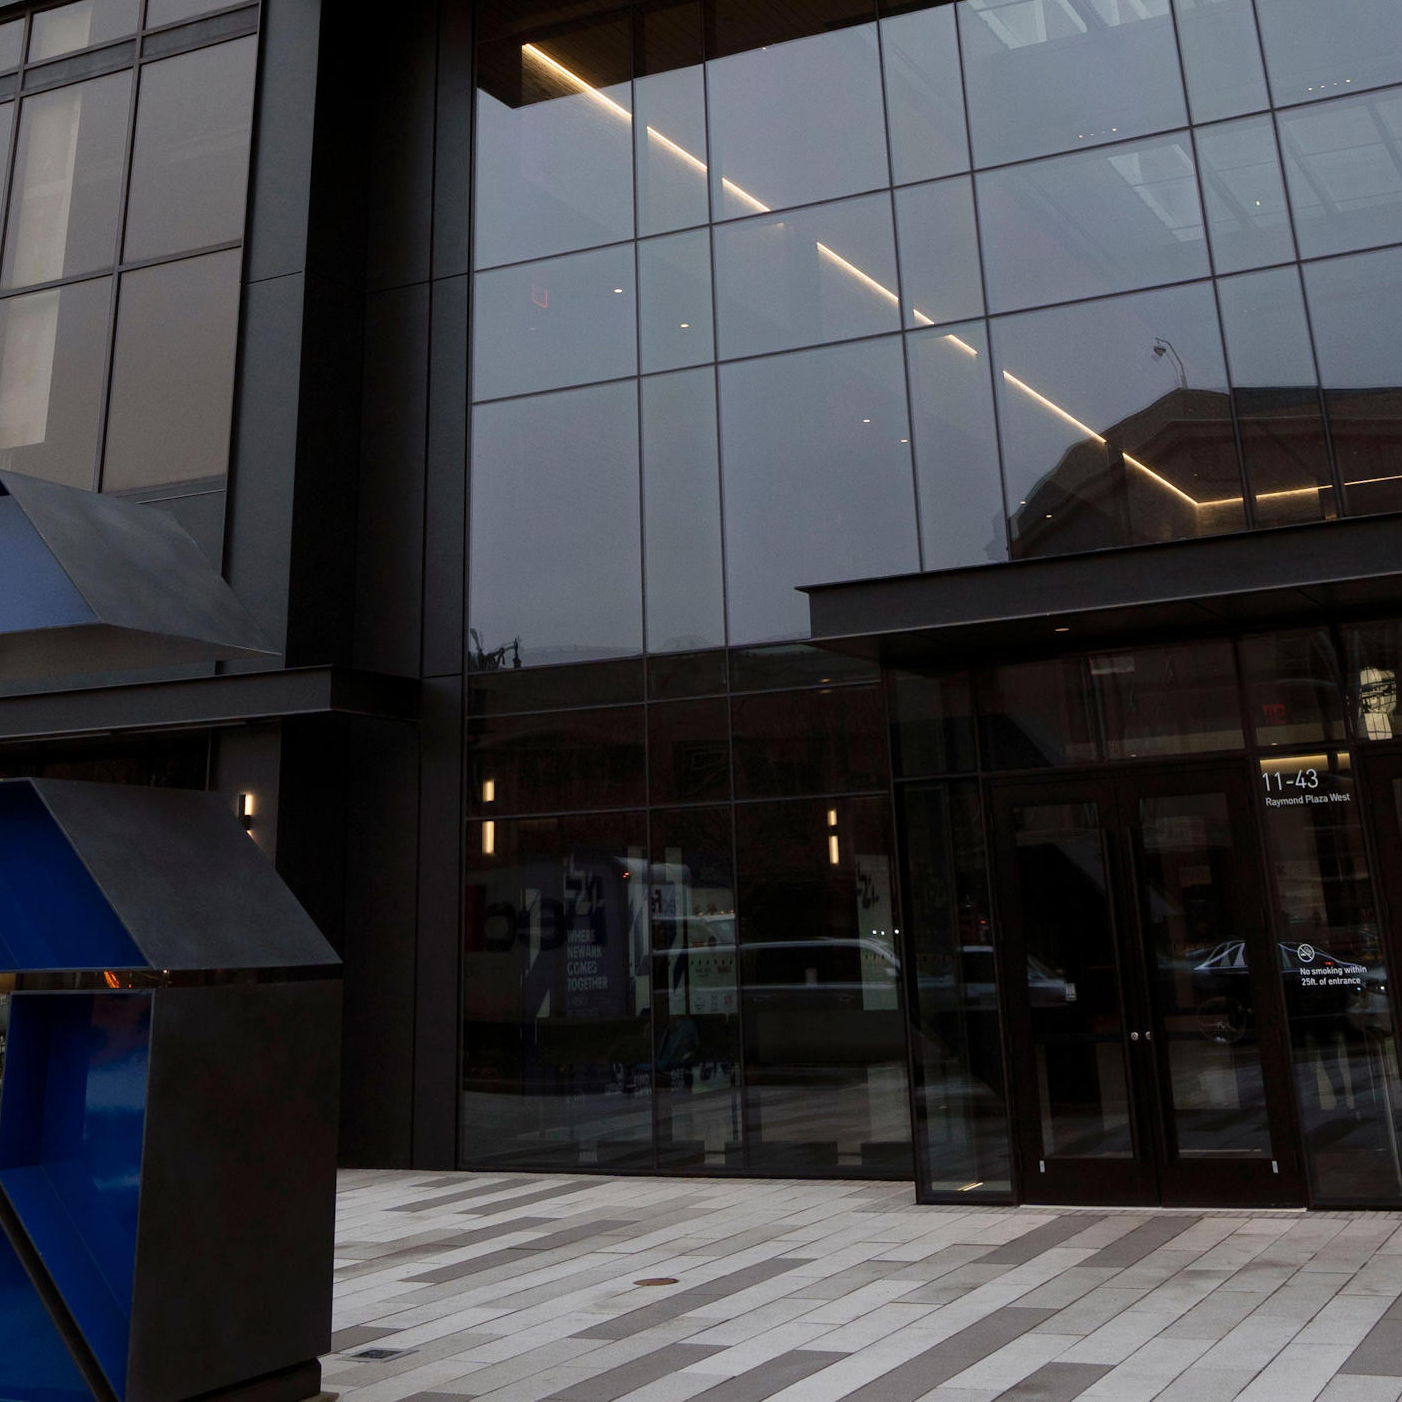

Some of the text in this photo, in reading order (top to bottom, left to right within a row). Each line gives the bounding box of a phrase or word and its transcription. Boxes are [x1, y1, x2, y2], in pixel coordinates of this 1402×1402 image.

[1262, 768, 1319, 792] 11-43
[1265, 792, 1350, 808] Raymond Plaza West
[566, 944, 603, 959] NEWARK
[566, 960, 598, 976] COMES
[1300, 965, 1367, 976] No smoking within
[566, 976, 608, 991] TOGETHER
[1302, 977, 1361, 986] 25ft. of entrance
